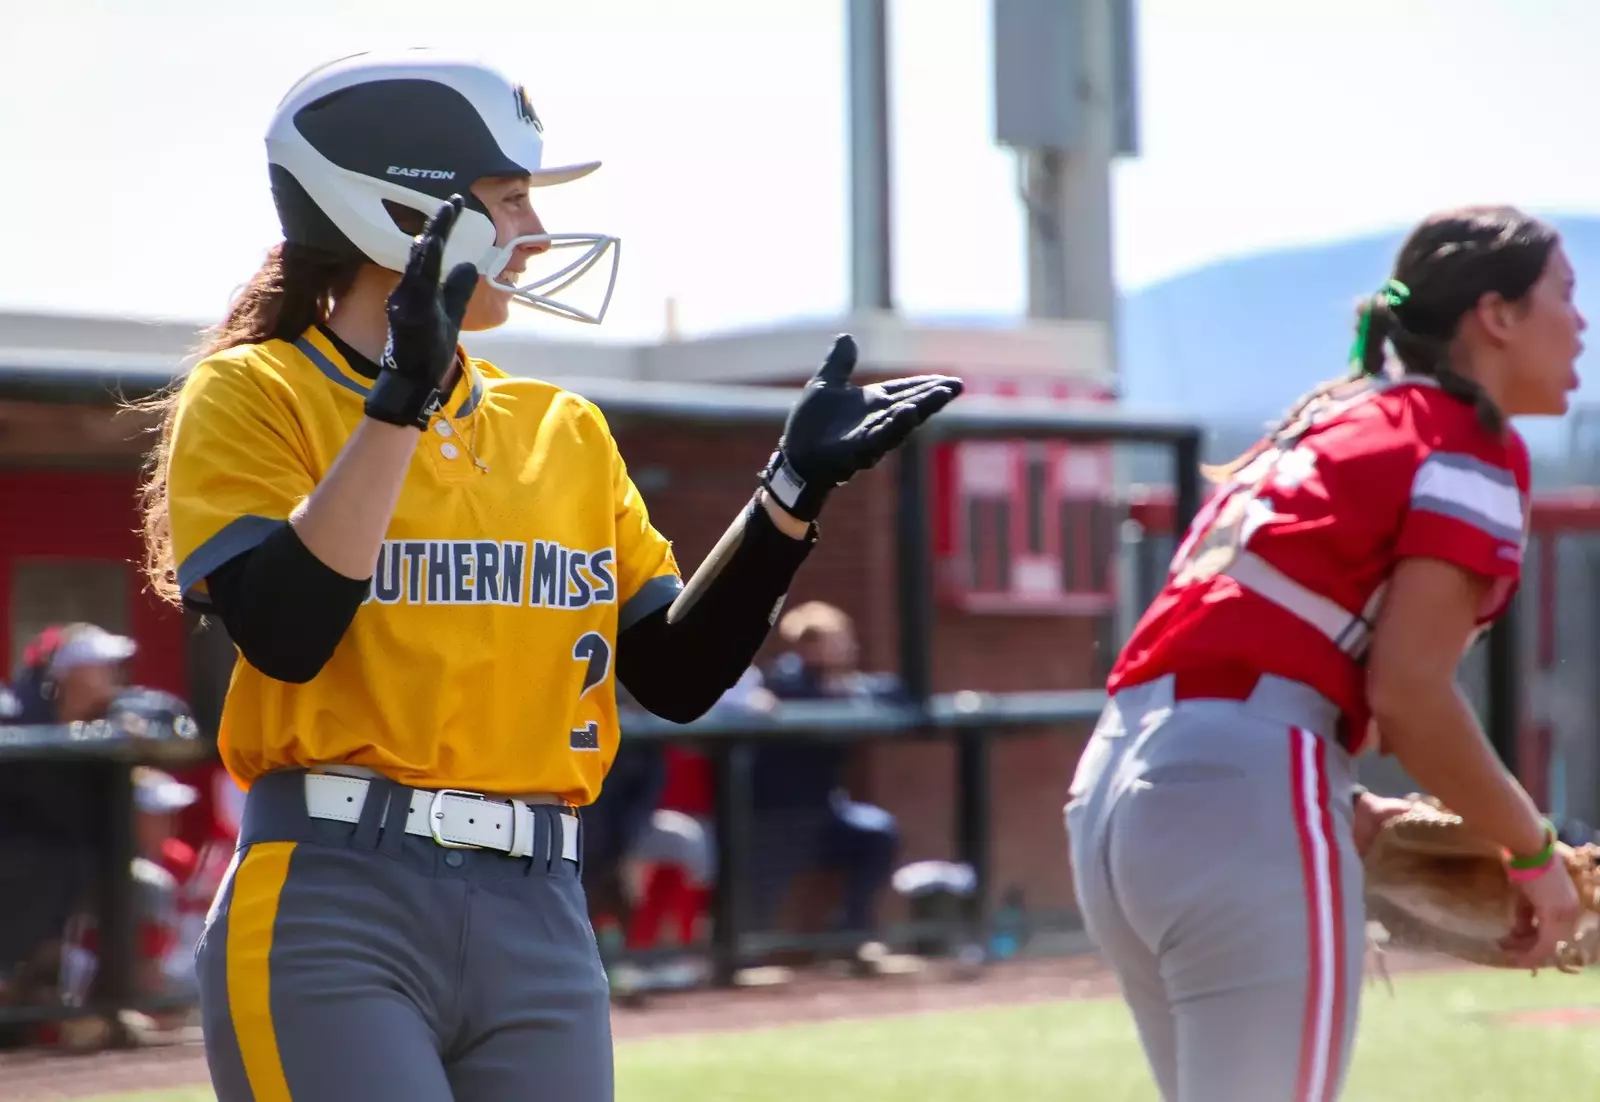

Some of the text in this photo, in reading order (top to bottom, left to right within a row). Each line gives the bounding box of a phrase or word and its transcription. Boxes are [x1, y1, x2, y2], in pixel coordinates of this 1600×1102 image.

[386, 166, 456, 180] EASTON
[361, 539, 616, 610] UTHERN MISS
